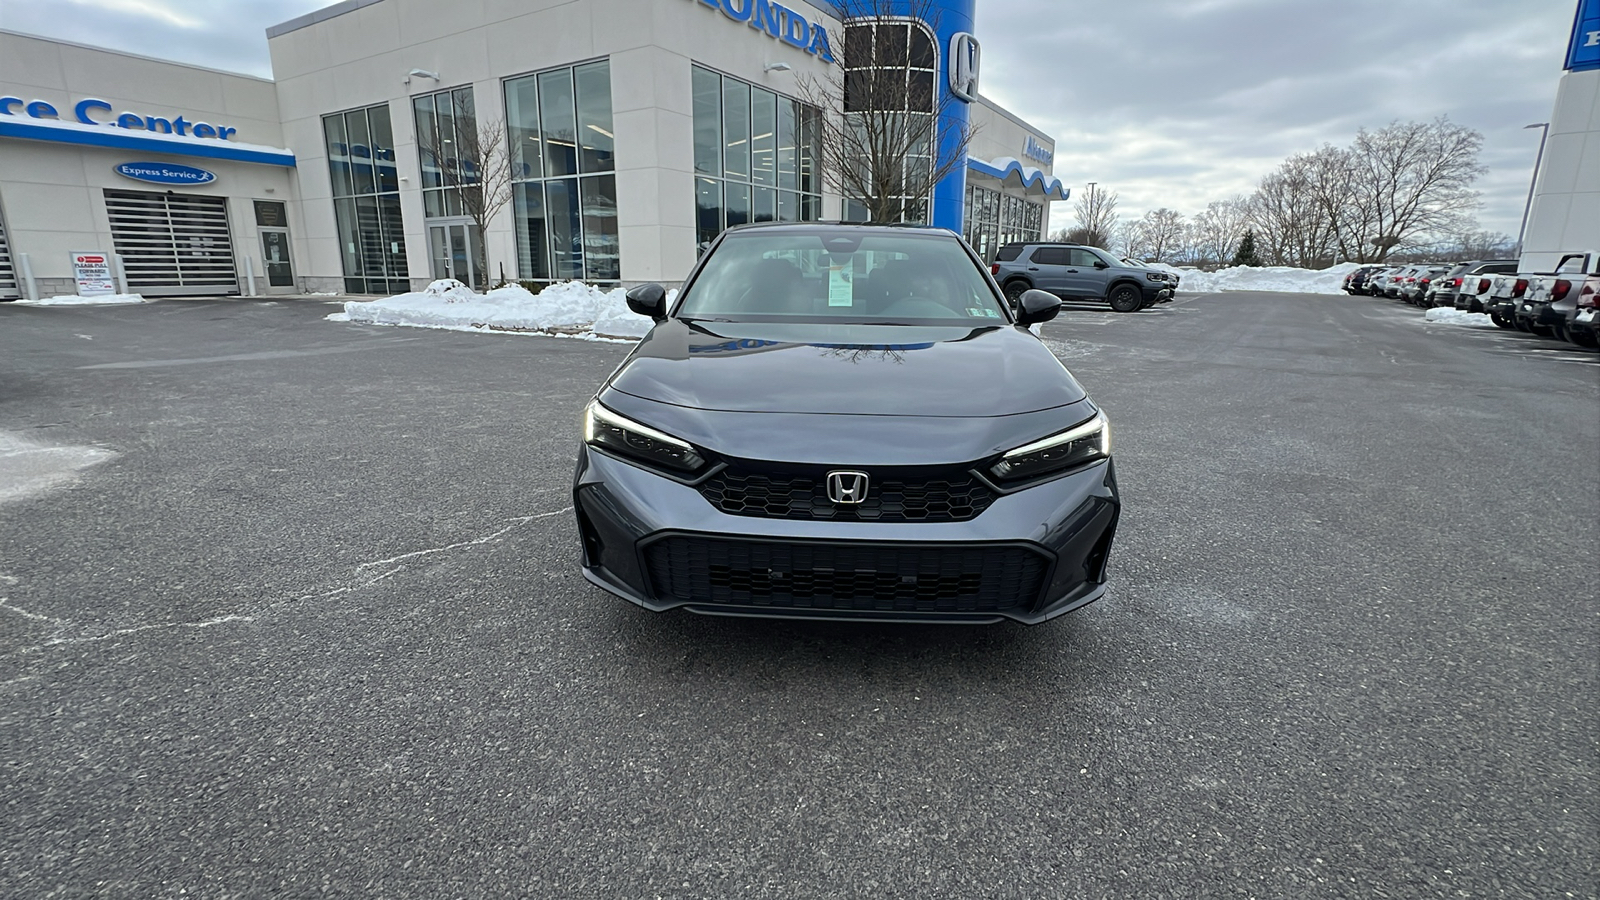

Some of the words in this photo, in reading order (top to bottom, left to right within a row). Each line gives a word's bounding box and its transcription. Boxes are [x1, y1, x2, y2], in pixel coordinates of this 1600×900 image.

[698, 0, 834, 63] ONDA
[75, 98, 237, 140] Center
[122, 165, 160, 176] Express
[162, 169, 197, 179] Service
